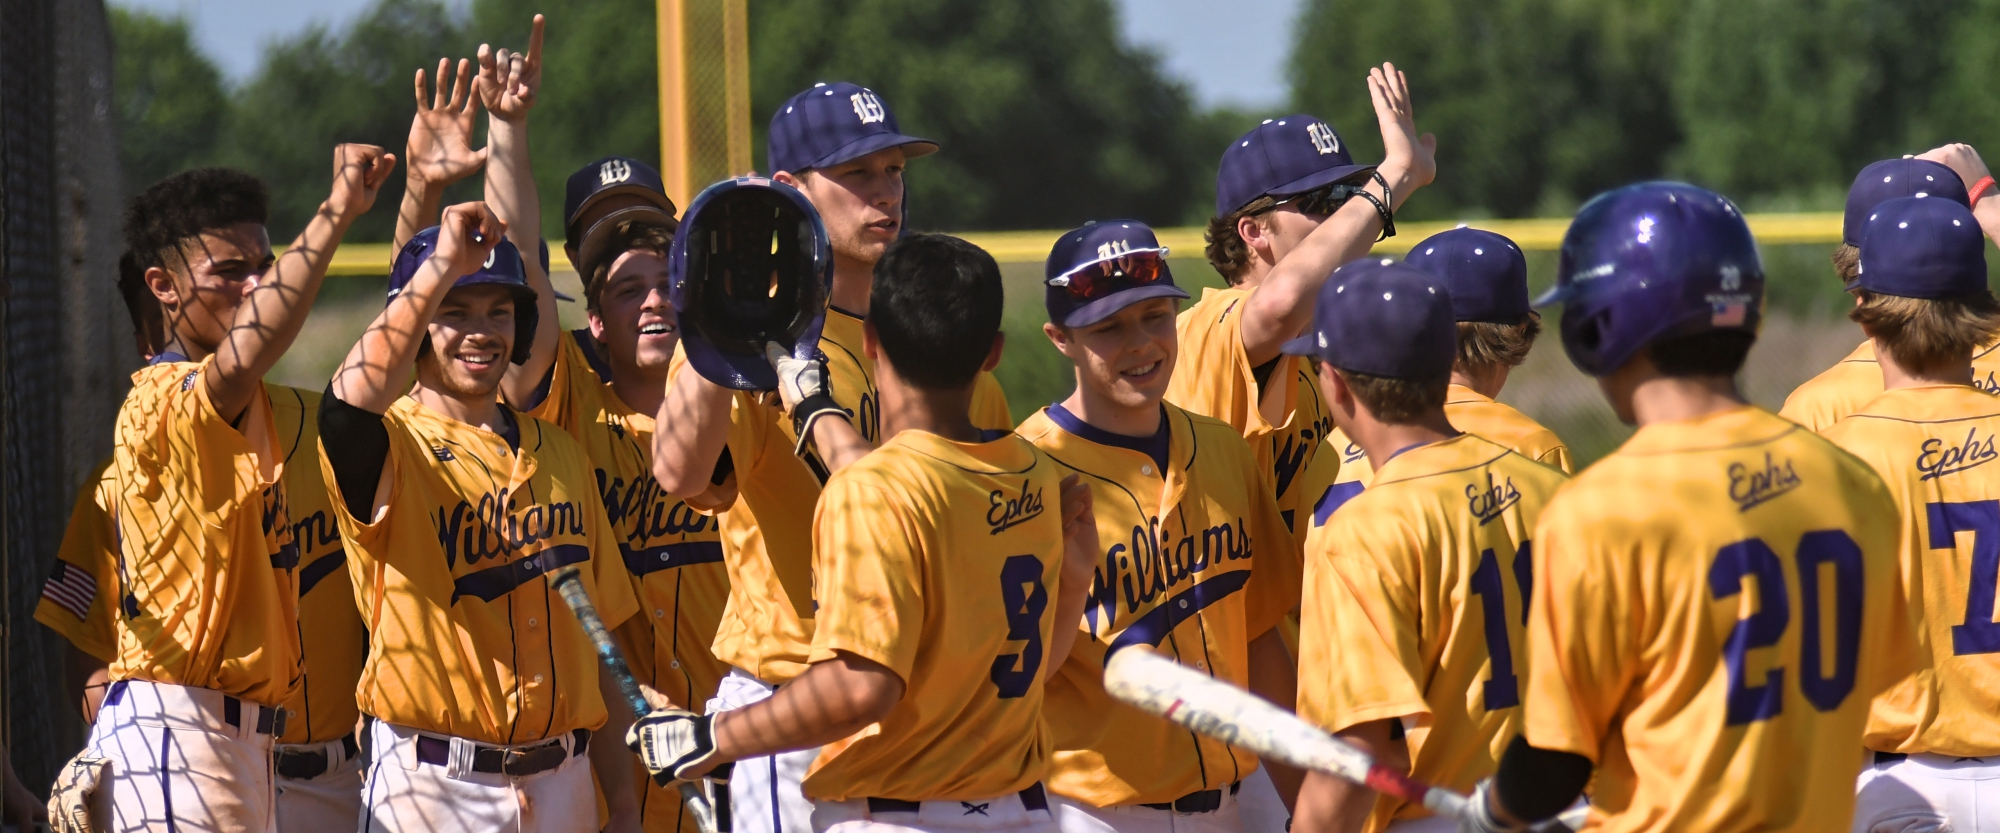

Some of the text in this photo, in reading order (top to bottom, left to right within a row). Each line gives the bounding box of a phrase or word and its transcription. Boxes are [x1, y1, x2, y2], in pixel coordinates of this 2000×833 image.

[850, 92, 885, 125] W
[1306, 122, 1339, 155] W
[599, 159, 631, 186] W
[1728, 452, 1802, 513] Ephs
[1916, 427, 1998, 482] Ephs
[987, 479, 1044, 536] Ephs
[1465, 473, 1521, 527] Ephs
[1084, 515, 1252, 642] Williams
[1926, 499, 2000, 656] 7
[990, 554, 1048, 698] 9
[1708, 528, 1866, 727] 20
